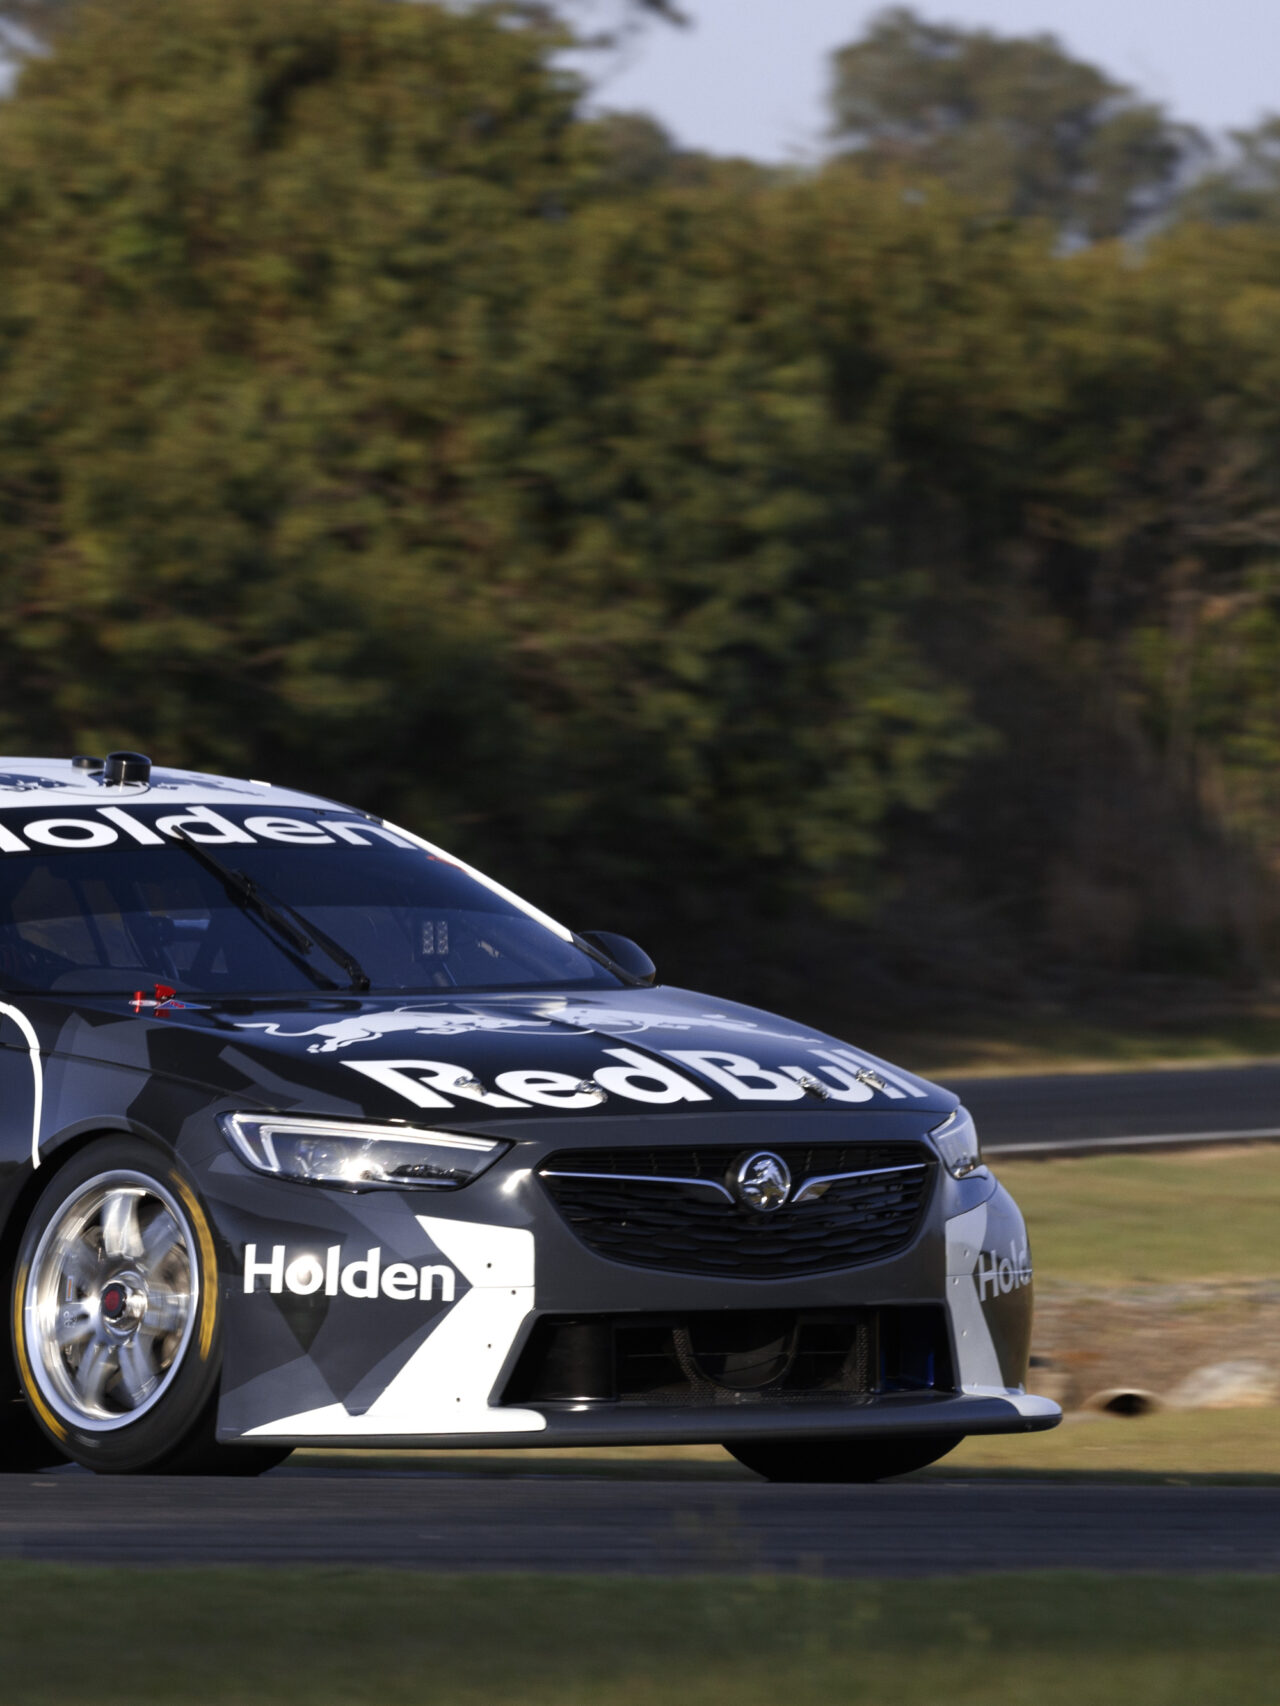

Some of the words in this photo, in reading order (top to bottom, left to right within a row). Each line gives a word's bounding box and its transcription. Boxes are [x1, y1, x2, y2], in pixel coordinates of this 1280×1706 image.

[340, 1047, 712, 1109] Red
[660, 1048, 928, 1103] Bull
[243, 1243, 456, 1302] Holden
[979, 1235, 1031, 1302] Hold
